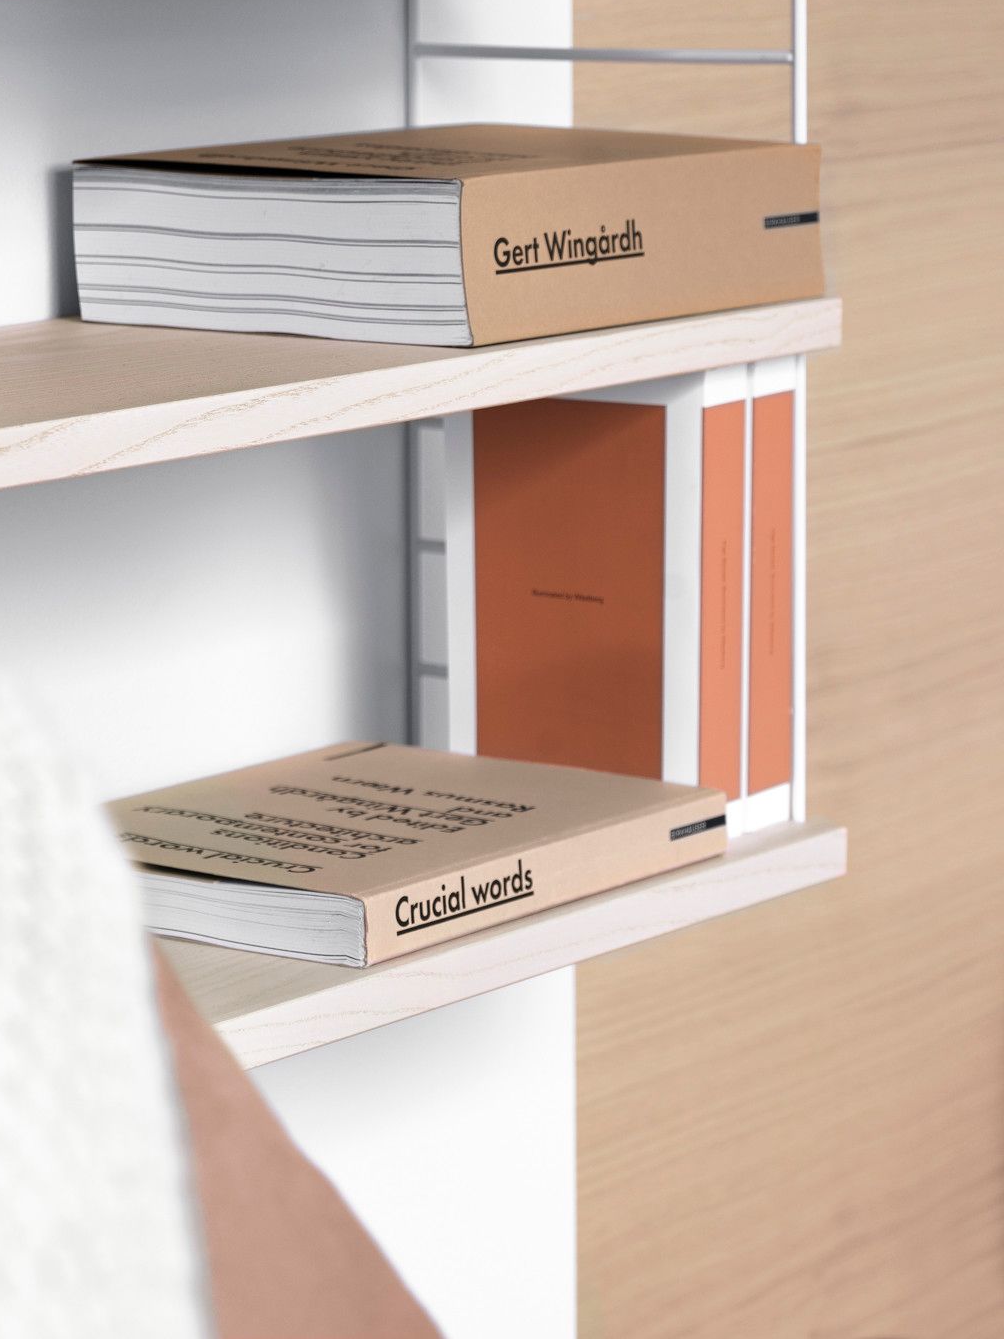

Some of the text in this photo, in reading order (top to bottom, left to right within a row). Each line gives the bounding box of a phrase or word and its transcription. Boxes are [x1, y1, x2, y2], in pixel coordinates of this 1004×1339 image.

[494, 220, 644, 268] Gert Wingårdh
[268, 785, 489, 826] Gert Wingårdh
[424, 791, 535, 812] Rasmus
[454, 806, 512, 819] and
[134, 806, 391, 853] for contemporary
[244, 812, 419, 846] architecture
[328, 806, 465, 833] Edited by
[210, 829, 368, 859] Conditions
[204, 851, 318, 874] Crucial
[396, 859, 534, 926] Crucial words
